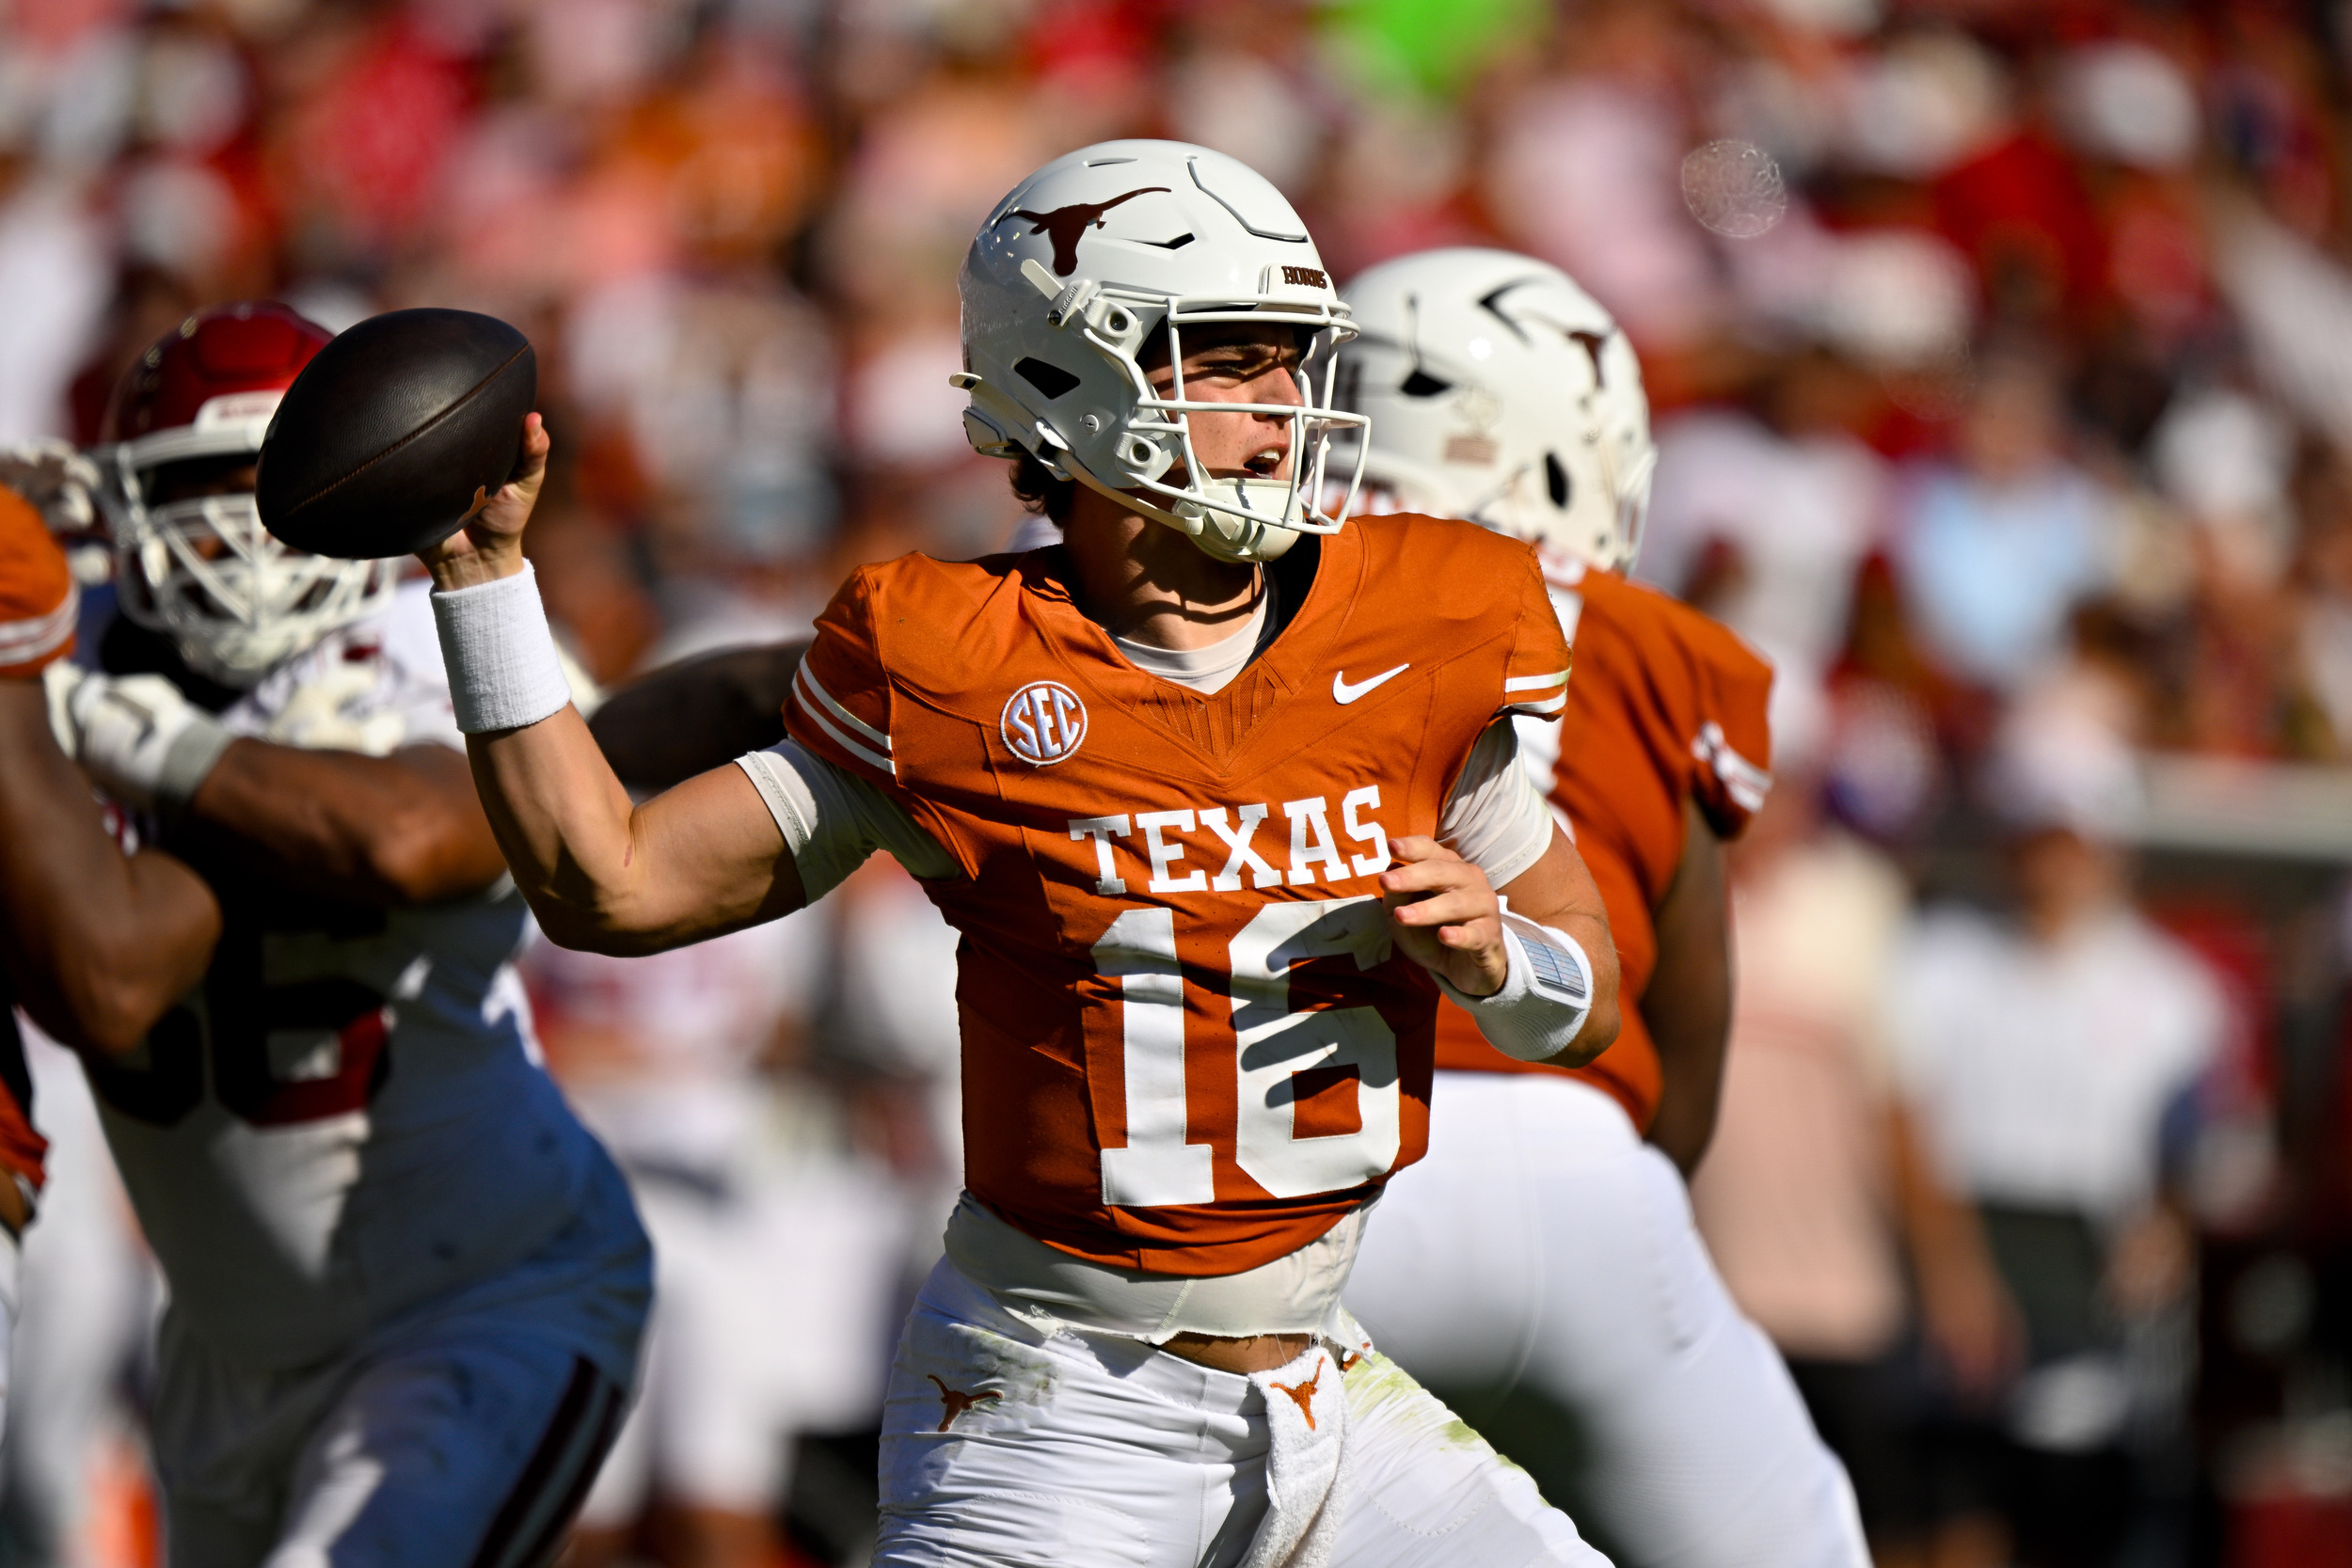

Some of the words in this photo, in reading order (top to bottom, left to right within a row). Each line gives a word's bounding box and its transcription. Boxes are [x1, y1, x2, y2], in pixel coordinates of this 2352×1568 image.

[1281, 266, 1327, 290] HORNS
[1009, 688, 1080, 758] SEC
[1068, 784, 1391, 895] TEXAS
[1090, 894, 1401, 1207] 16
